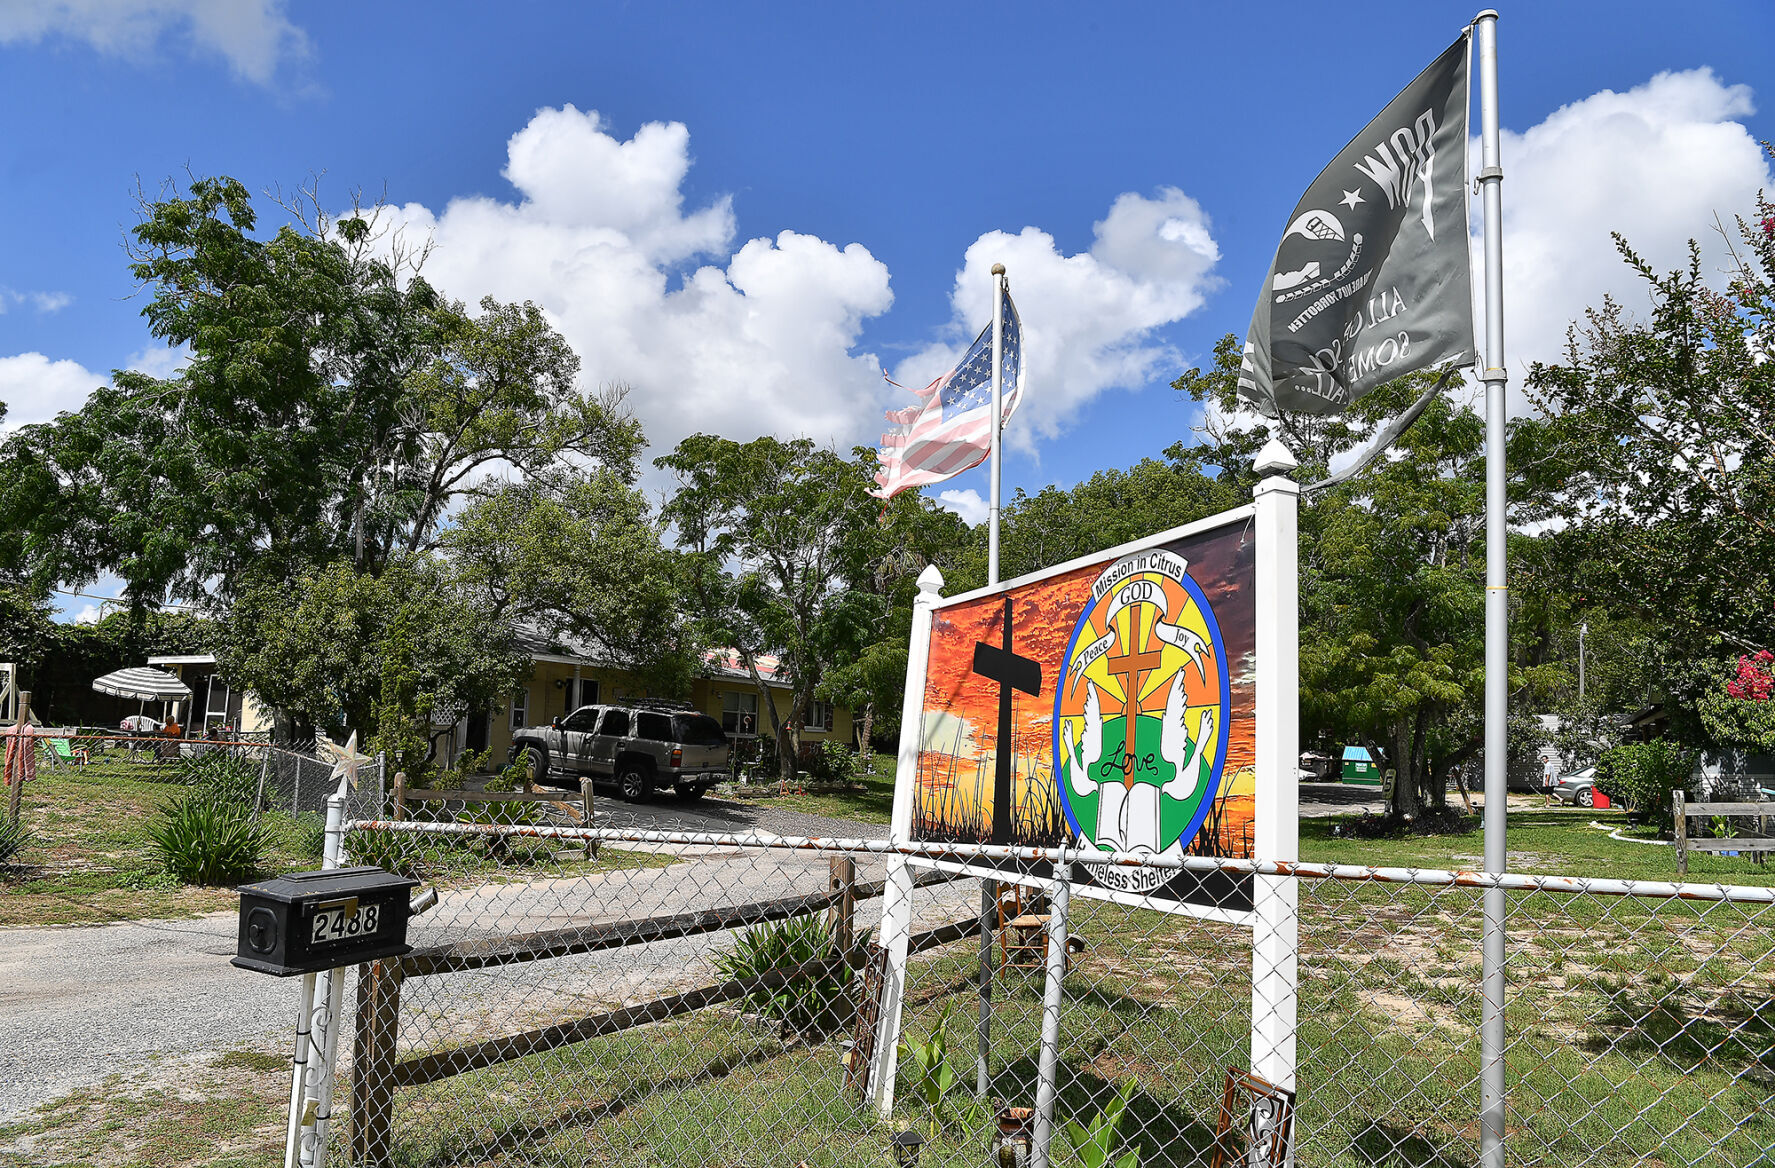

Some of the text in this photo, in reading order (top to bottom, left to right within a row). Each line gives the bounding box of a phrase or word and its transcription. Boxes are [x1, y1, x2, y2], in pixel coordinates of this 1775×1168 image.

[1095, 552, 1182, 598] Mission in Citrus
[1120, 582, 1153, 605] GOD
[1174, 628, 1190, 647] Joy
[1083, 639, 1109, 664] Peace
[1101, 740, 1159, 777] Love
[1384, 776, 1394, 793] 5
[314, 905, 378, 941] 2488
